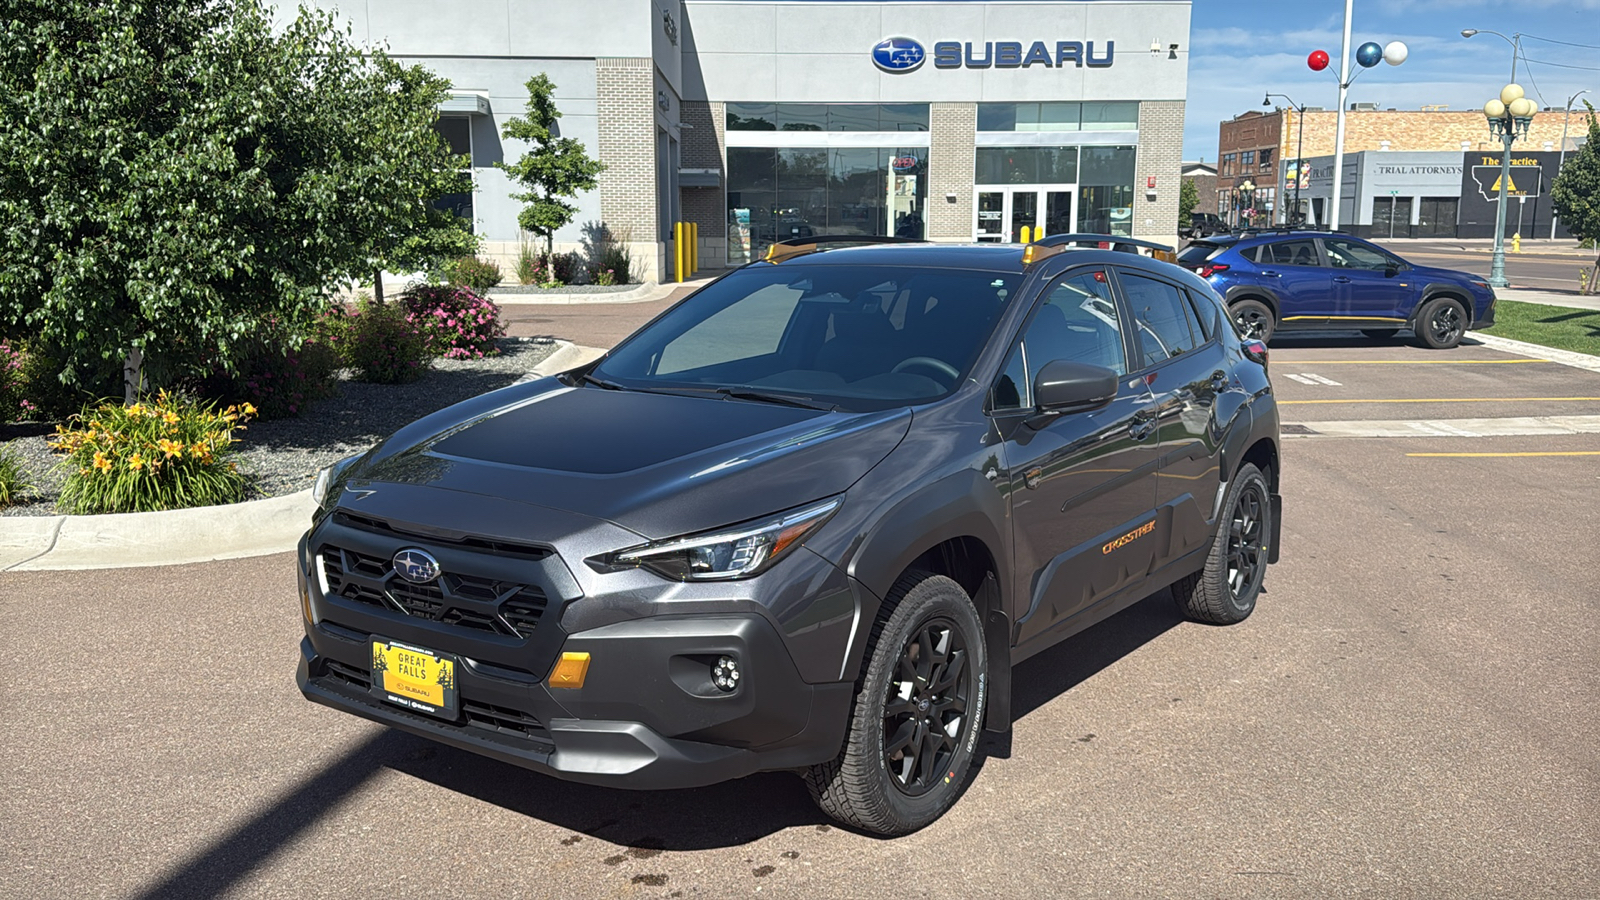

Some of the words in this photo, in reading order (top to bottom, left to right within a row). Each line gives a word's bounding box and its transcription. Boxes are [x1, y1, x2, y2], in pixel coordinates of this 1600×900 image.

[934, 41, 1115, 69] SUBARU
[893, 157, 915, 168] OPEN
[1482, 156, 1500, 166] The
[1503, 156, 1538, 166] ractice
[1379, 166, 1407, 175] TRIAL
[1409, 166, 1463, 175] ATTORNEYS
[1102, 519, 1156, 555] CROSSTREK
[398, 652, 426, 668] GREAT
[398, 663, 427, 680] FALLS
[405, 685, 430, 697] SUBARU
